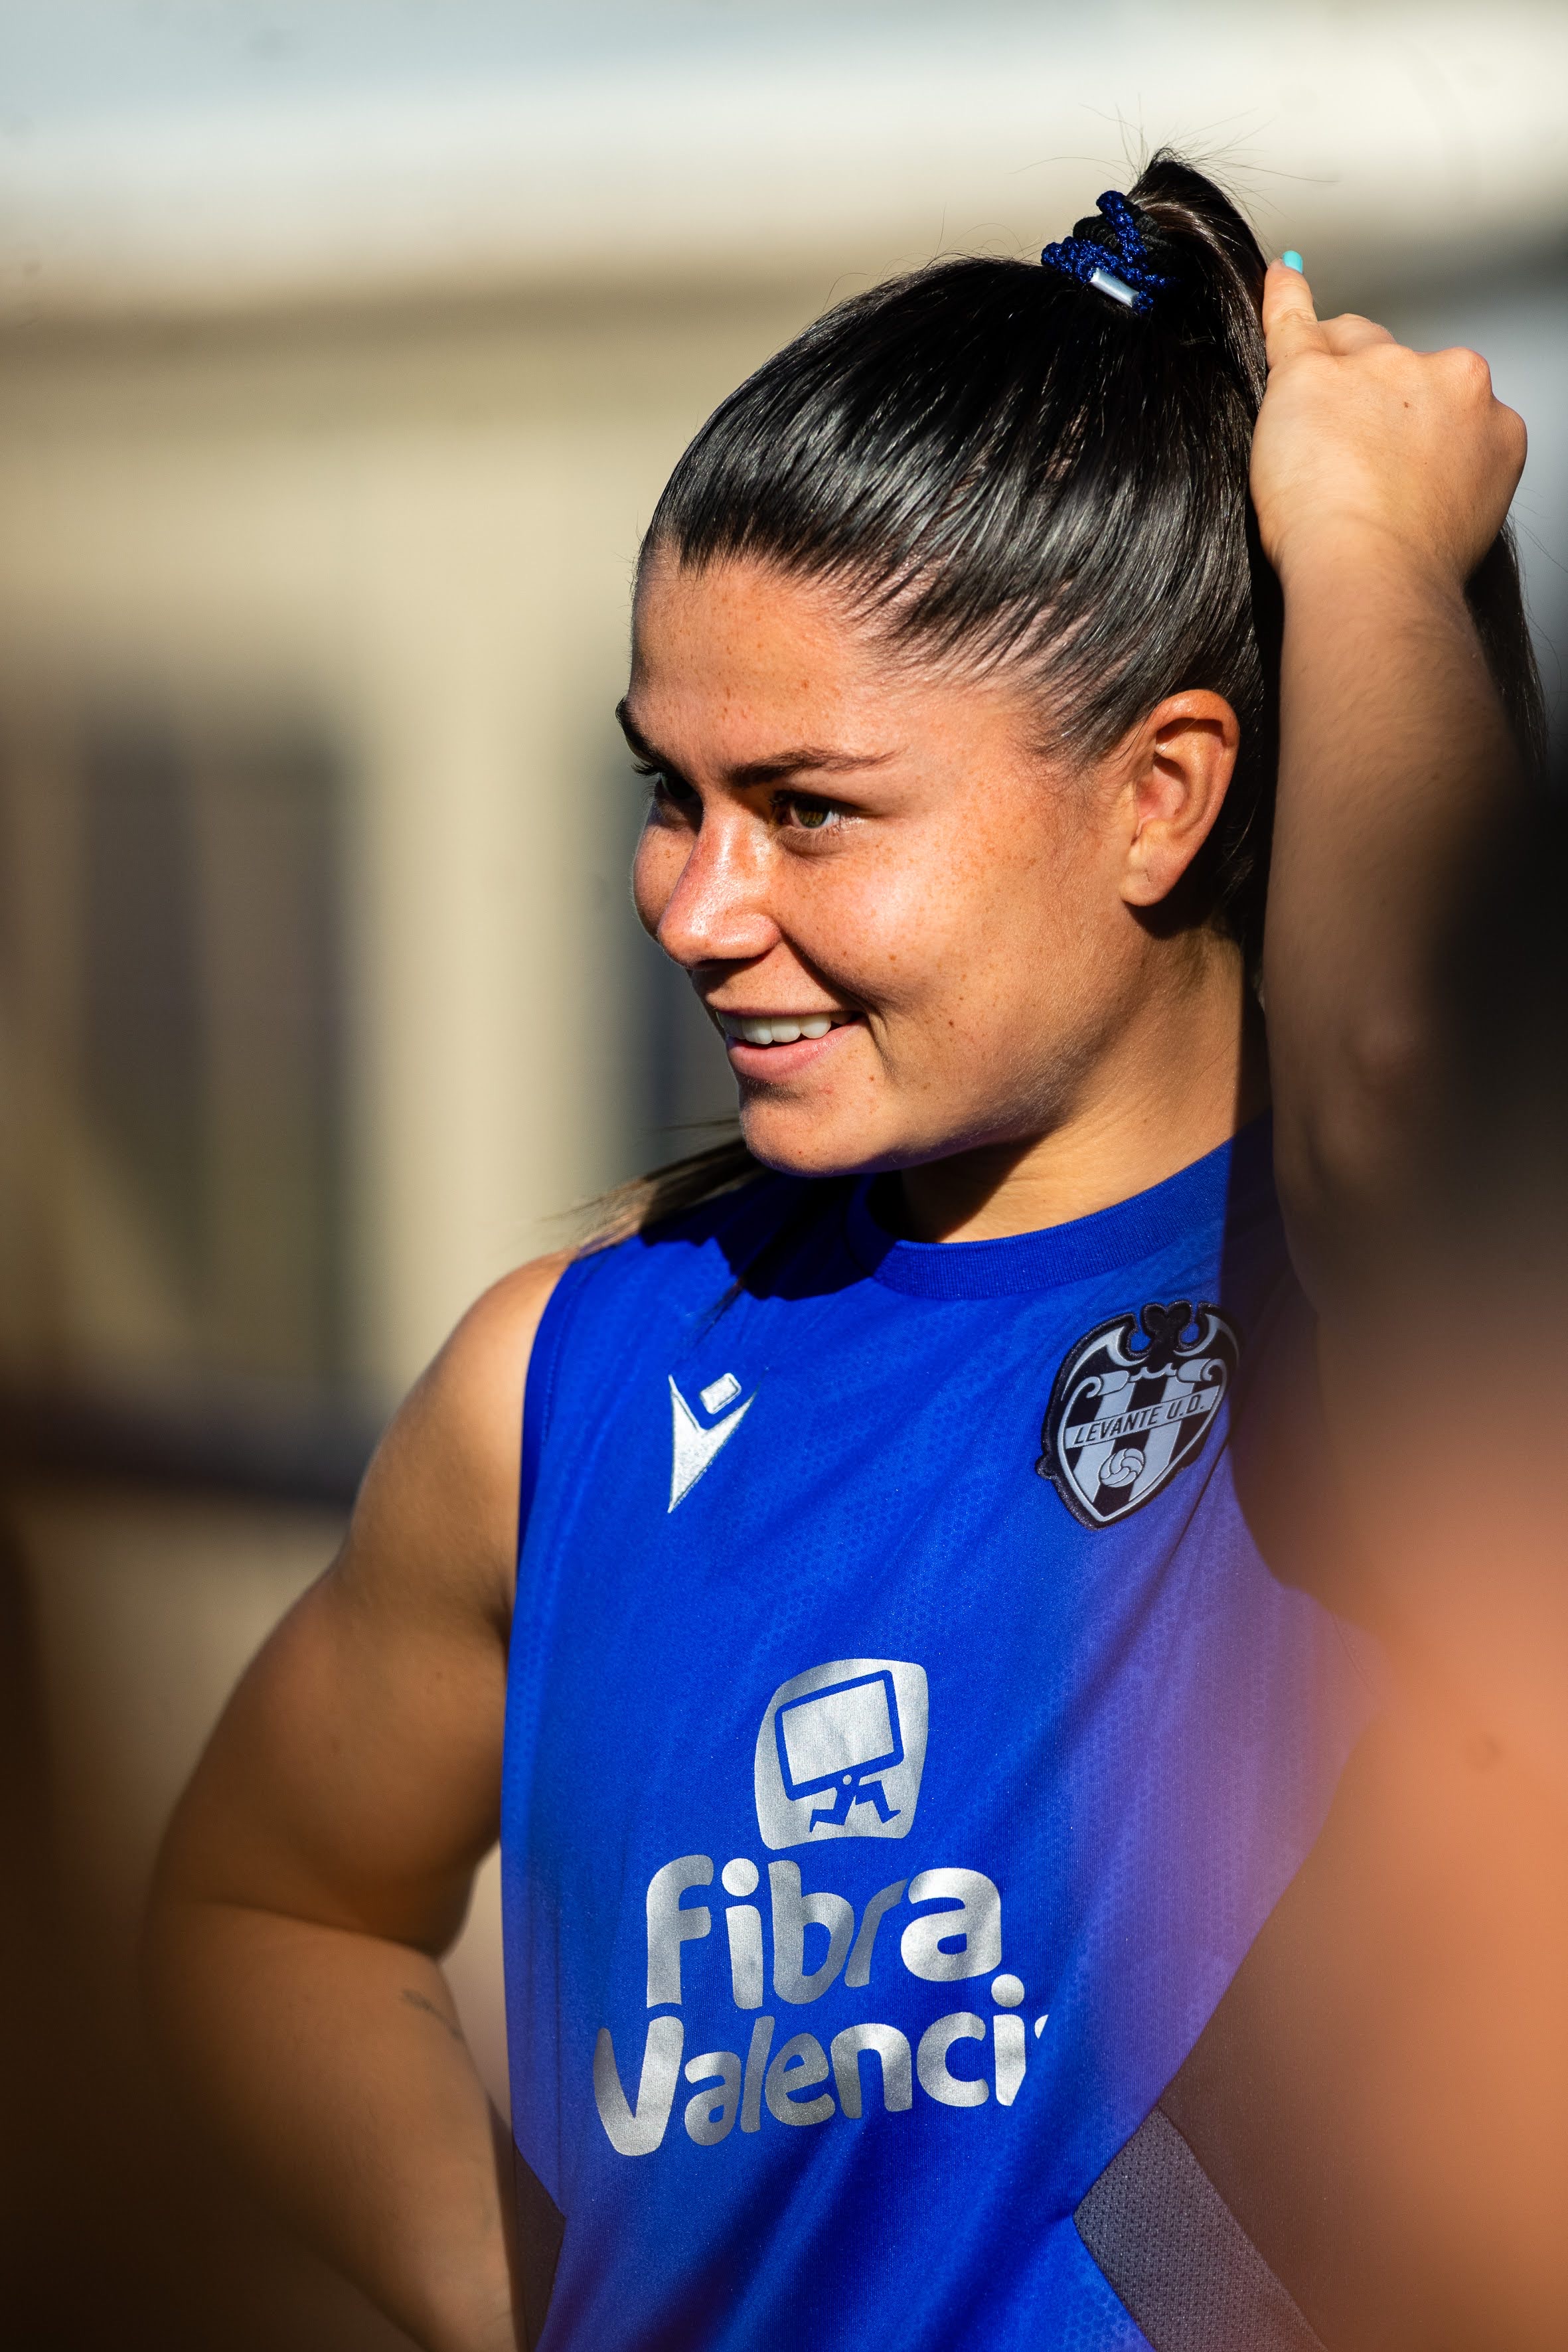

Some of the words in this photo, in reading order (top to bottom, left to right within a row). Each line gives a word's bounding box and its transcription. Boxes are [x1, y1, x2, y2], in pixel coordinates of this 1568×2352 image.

[1073, 1405, 1162, 1445] LEVANTE
[1166, 1394, 1204, 1419] U.D.
[647, 1854, 1002, 2009] fibra
[593, 1974, 1049, 2156] Valenci
